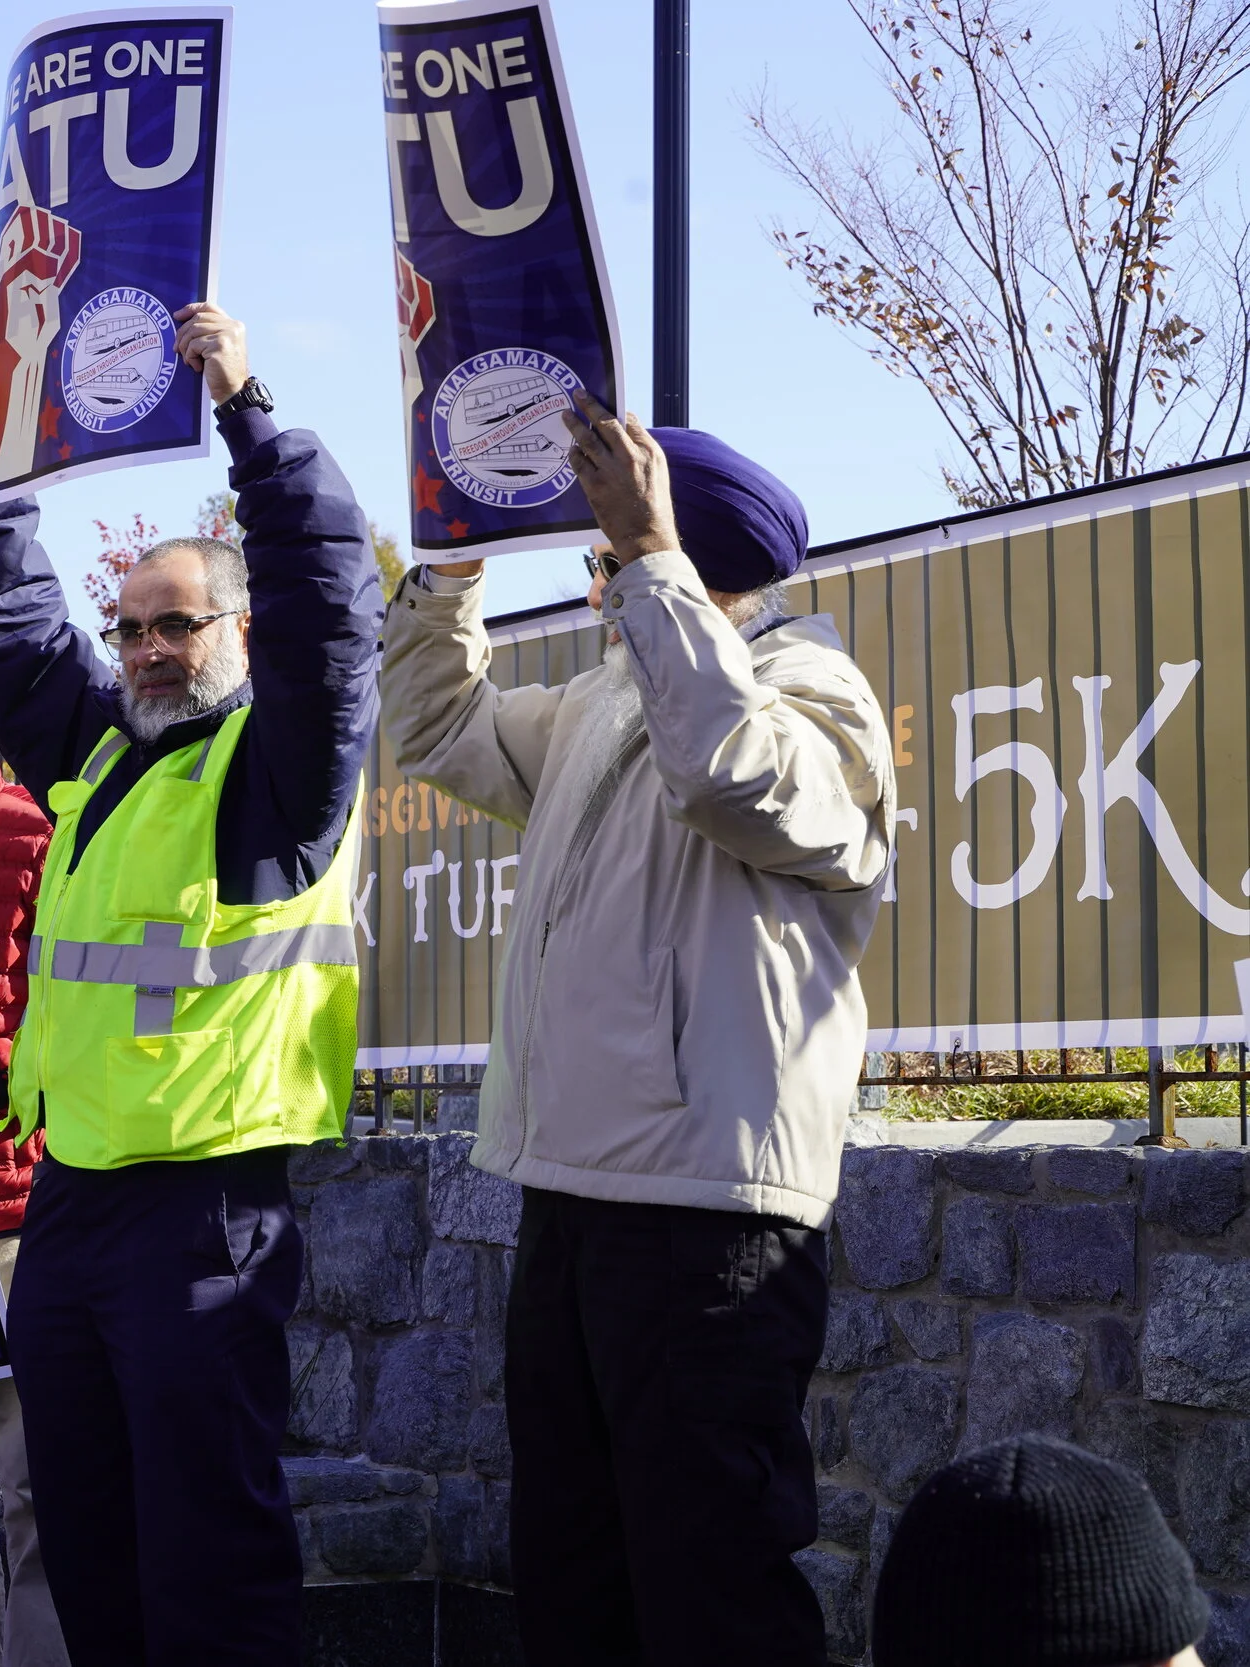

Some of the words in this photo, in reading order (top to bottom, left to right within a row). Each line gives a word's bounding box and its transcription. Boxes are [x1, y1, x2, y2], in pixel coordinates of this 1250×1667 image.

[24, 46, 92, 104] ARE
[104, 39, 205, 78] ONE
[415, 36, 533, 98] ONE
[66, 289, 171, 352] AMALGAMATED
[76, 367, 98, 383] FREEDOM
[97, 354, 119, 373] THROUGH
[119, 337, 158, 358] ORGANIZATION
[436, 350, 577, 421] AMALGAMATED
[63, 378, 107, 430] TRANSIT
[133, 361, 174, 418] UNION
[459, 439, 488, 457] FREEDOM
[488, 421, 517, 444] THROUGH
[518, 397, 566, 428] ORGANIZATION
[442, 451, 516, 505] TRANSIT
[950, 659, 1250, 936] 5K
